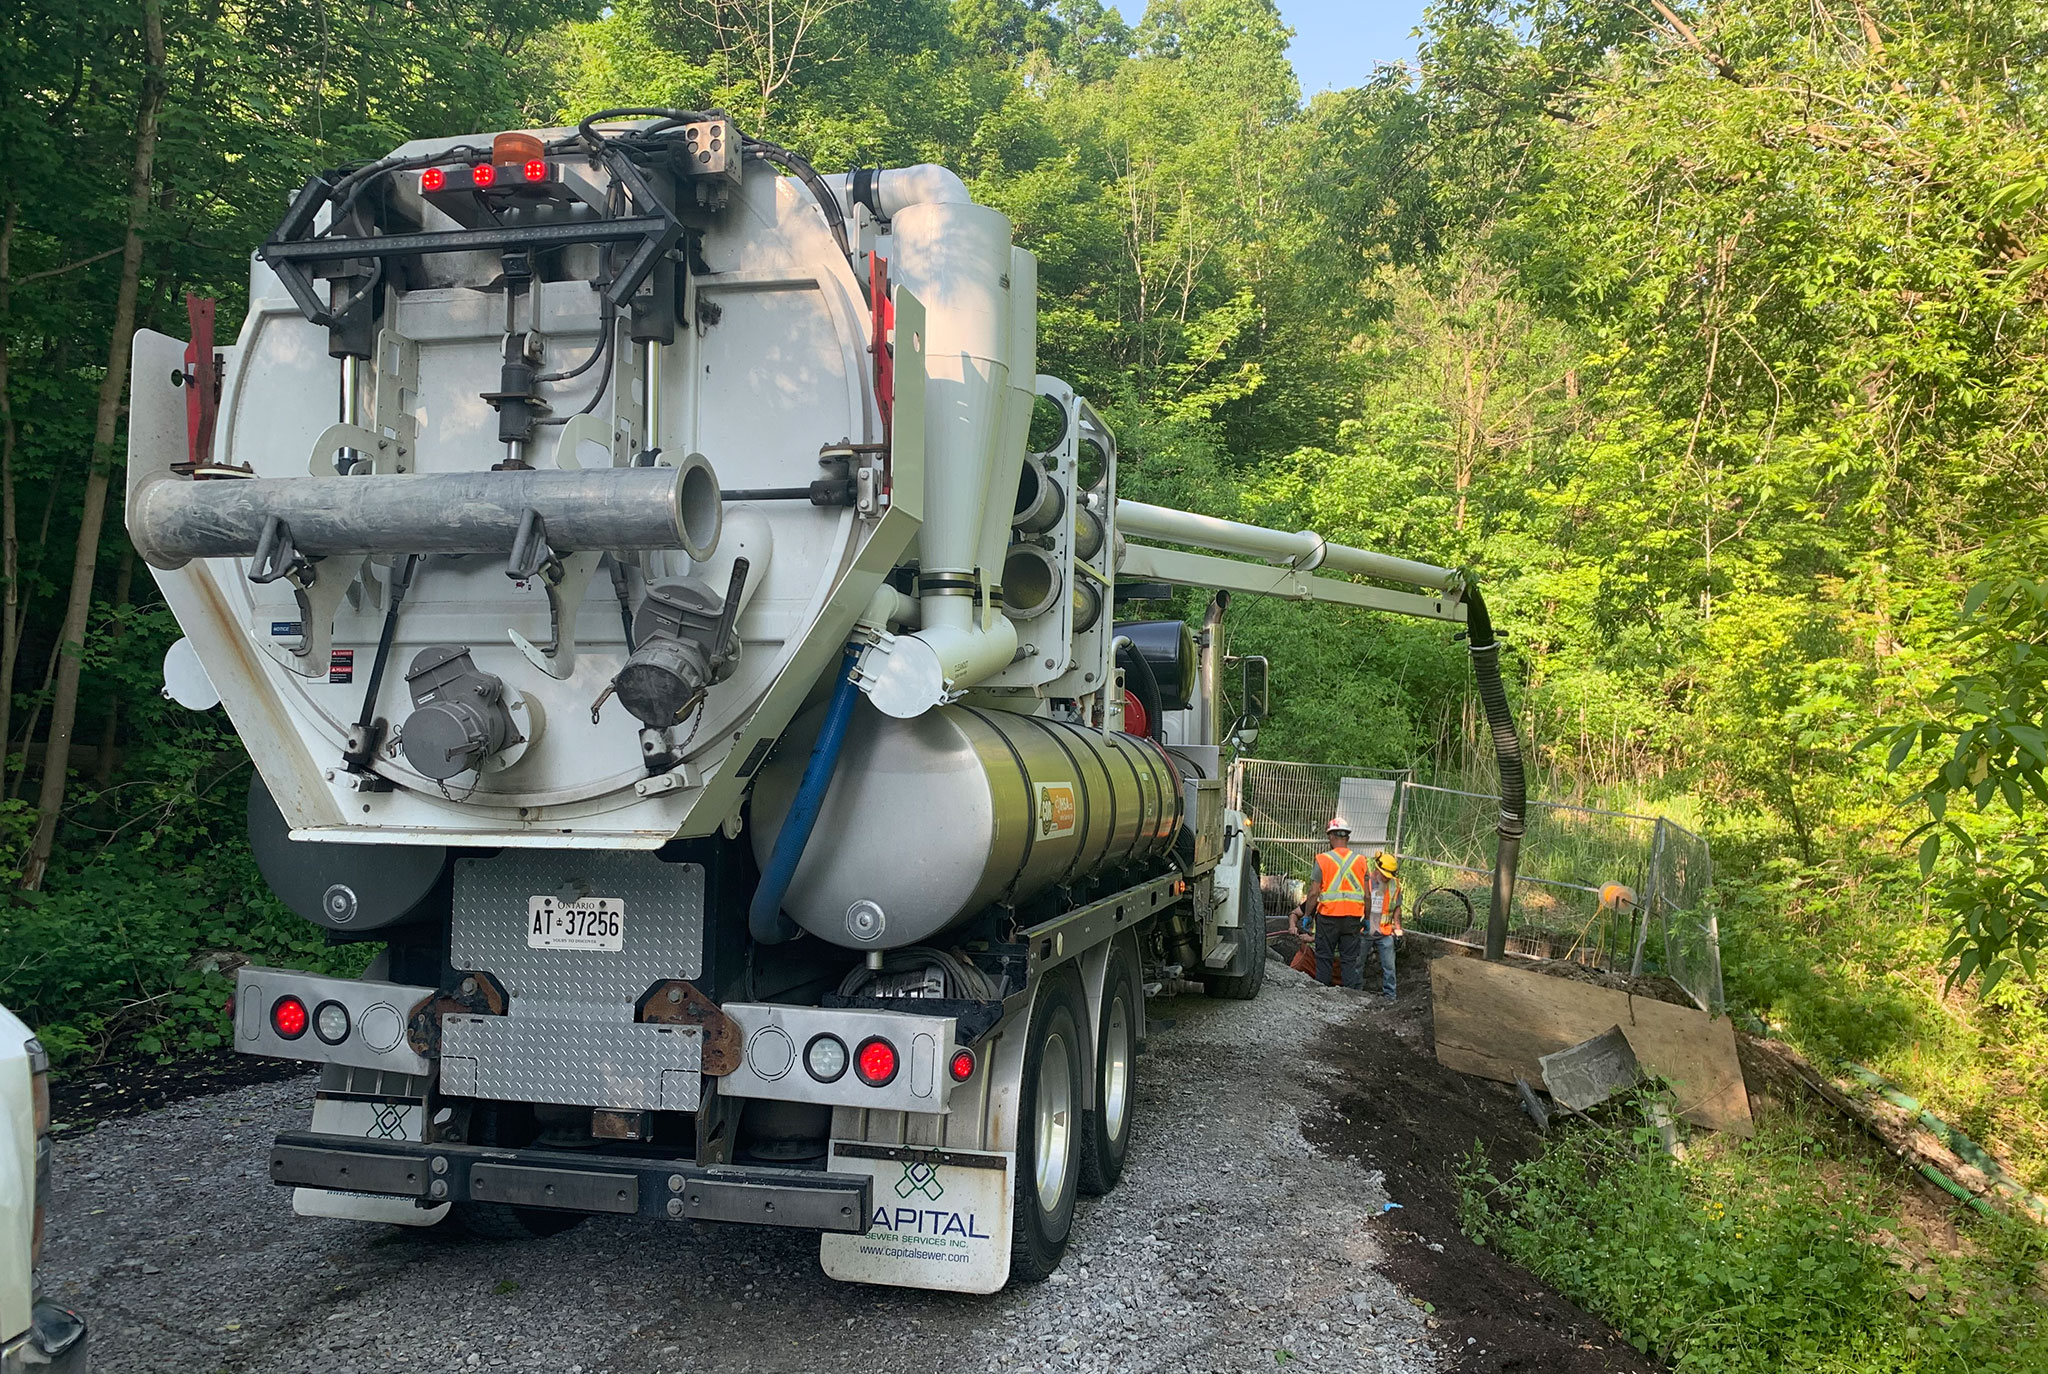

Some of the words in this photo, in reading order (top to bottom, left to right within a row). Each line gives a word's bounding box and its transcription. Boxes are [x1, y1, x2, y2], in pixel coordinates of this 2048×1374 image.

[557, 901, 595, 910] ONTARIO
[533, 909, 554, 935] AT
[565, 910, 619, 936] 37256
[872, 1206, 990, 1239] APITAL
[864, 1232, 899, 1242] SEWER
[901, 1235, 947, 1246] SERVICES
[859, 1245, 970, 1263] www.capitalsewer.com
